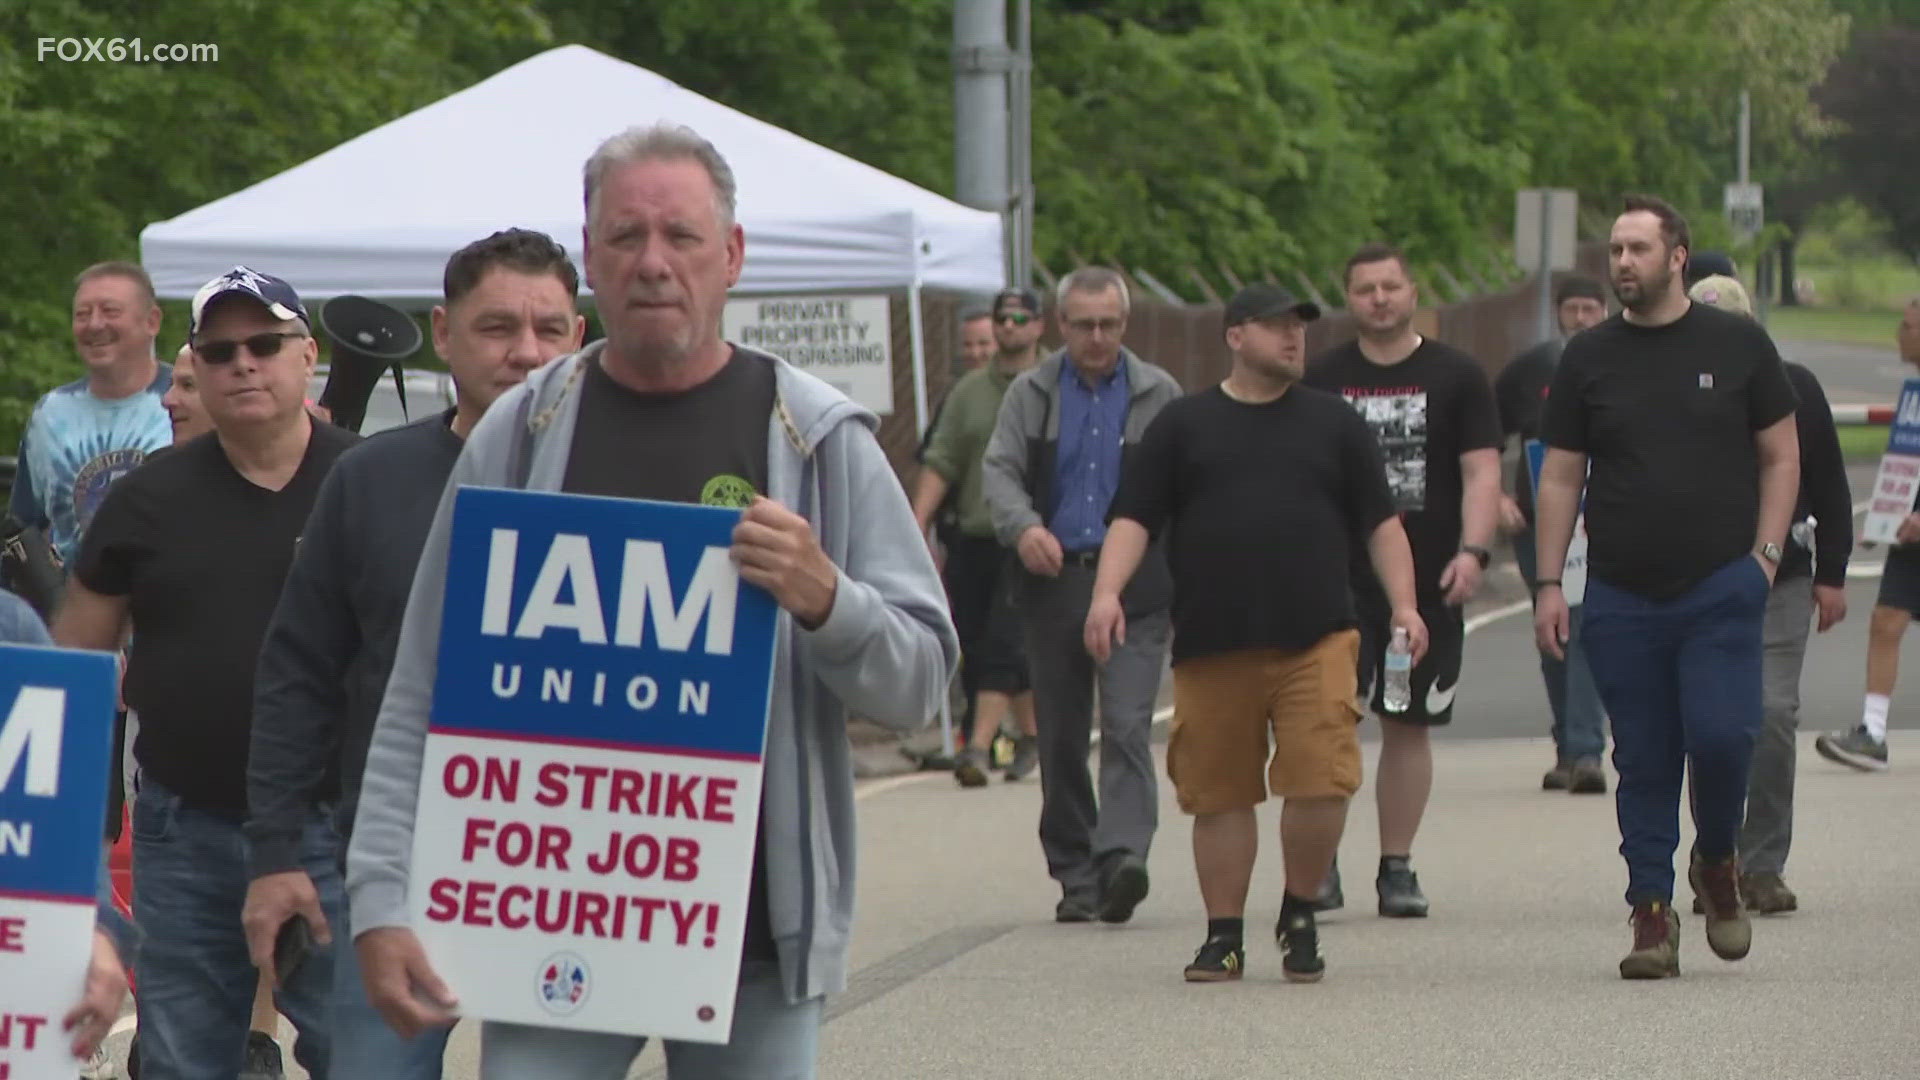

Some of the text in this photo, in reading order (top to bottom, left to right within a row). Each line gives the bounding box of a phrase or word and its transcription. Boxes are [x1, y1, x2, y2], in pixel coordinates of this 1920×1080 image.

[740, 321, 869, 344] PROPERTY
[758, 302, 851, 321] PRIVATE
[482, 529, 739, 654] IAM
[493, 665, 709, 714] UNION
[442, 754, 738, 824] ON STRIKE
[462, 817, 701, 882] FOR JOB
[425, 877, 720, 949] SECURITY!
